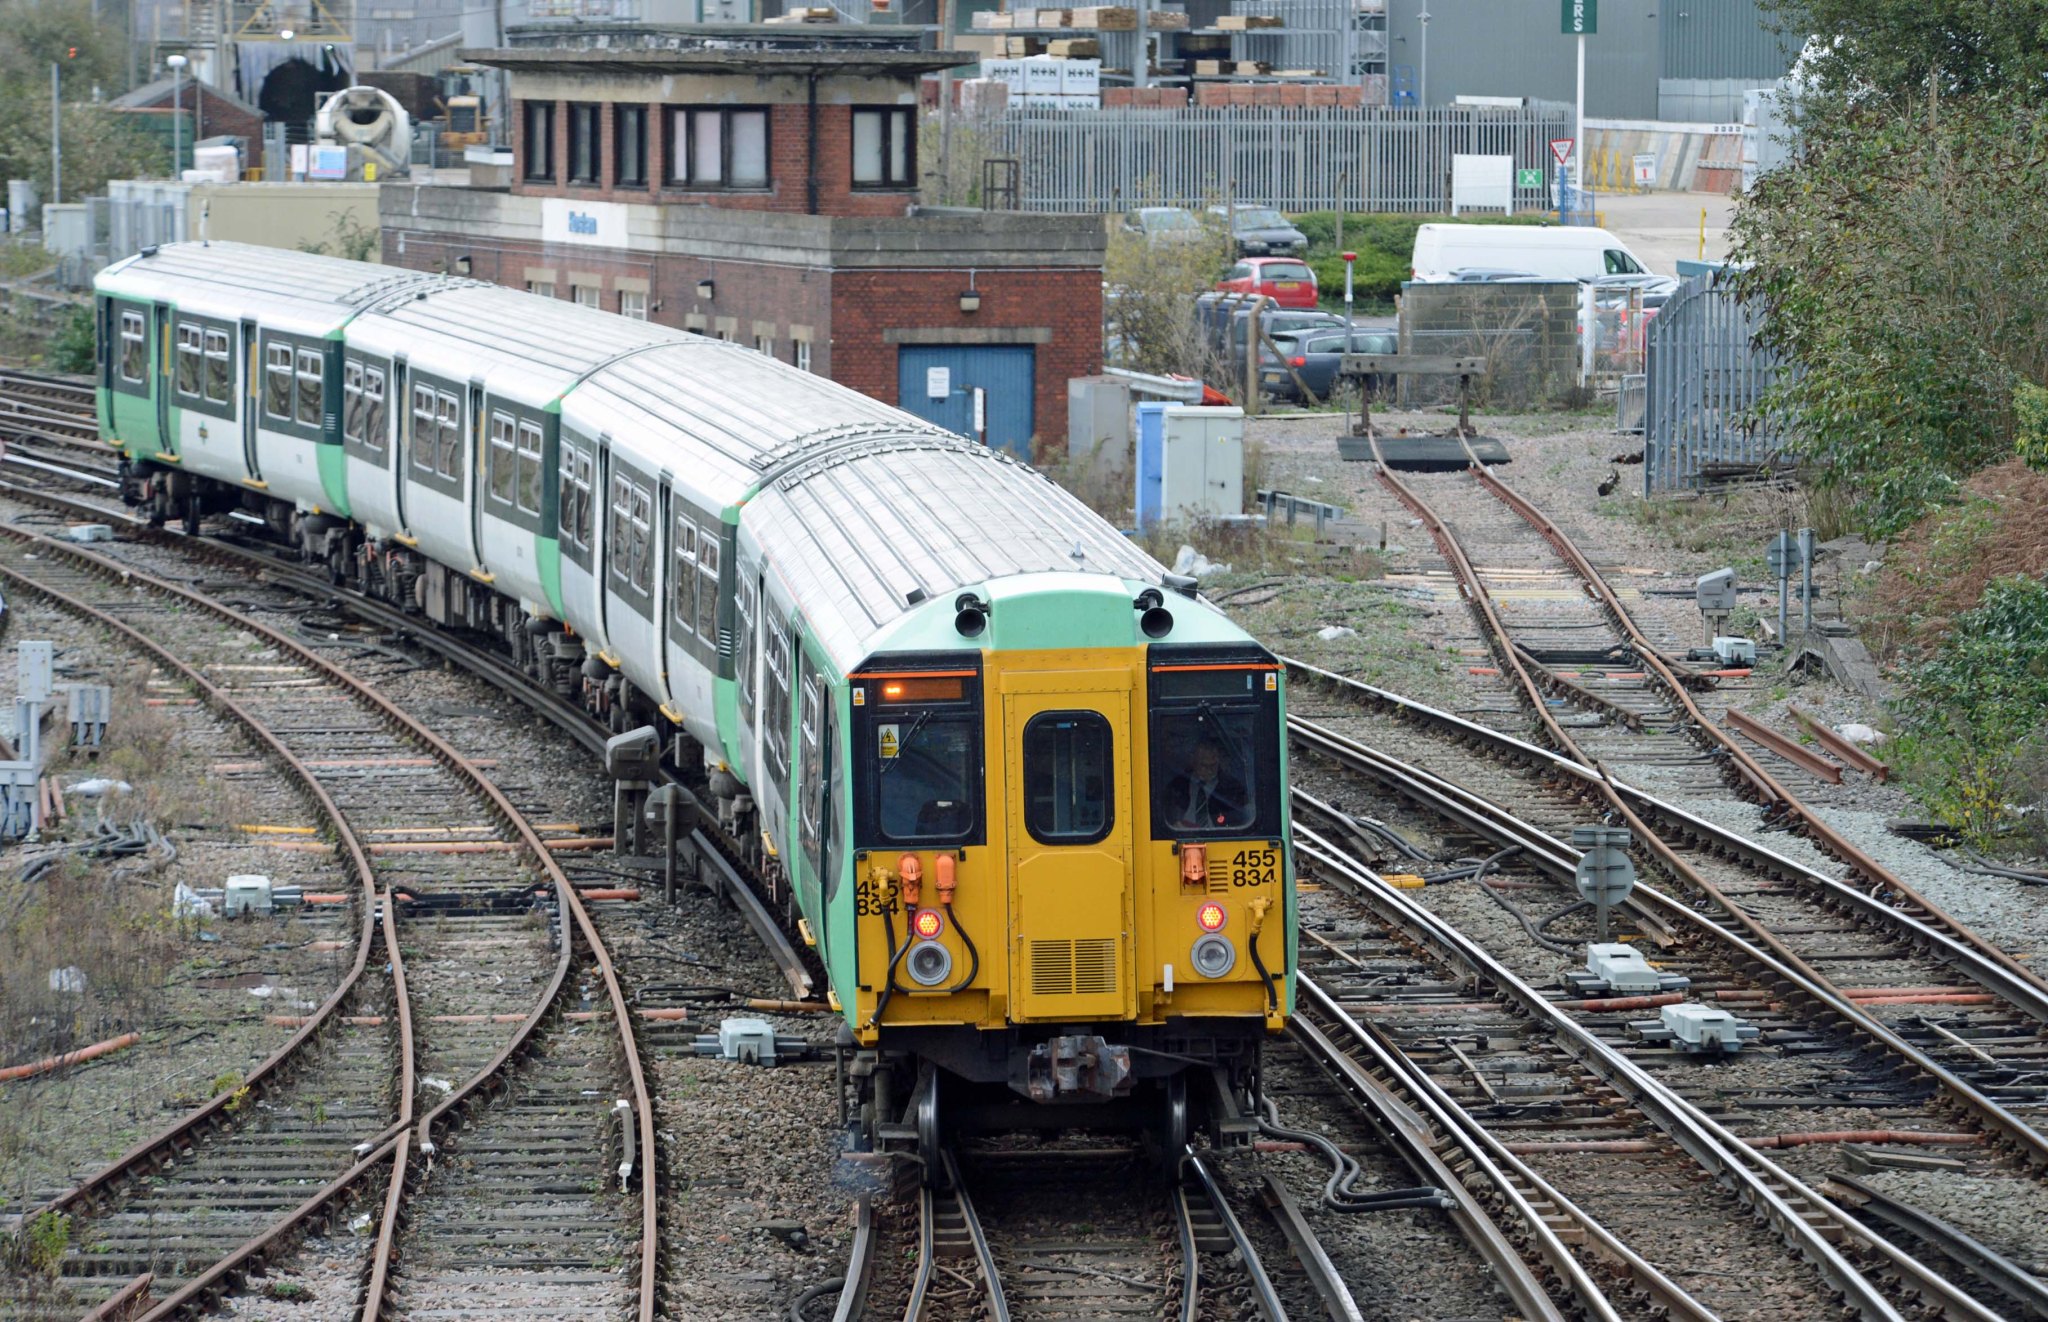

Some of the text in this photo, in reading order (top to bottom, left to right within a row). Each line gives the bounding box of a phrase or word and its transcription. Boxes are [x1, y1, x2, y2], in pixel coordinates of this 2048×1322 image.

[1573, 0, 1584, 32] RS
[993, 66, 1019, 76] H+H
[1031, 66, 1057, 77] H+H
[1067, 68, 1095, 78] H+H
[1232, 849, 1276, 868] 455
[1232, 868, 1277, 888] 834
[857, 897, 899, 917] 834
